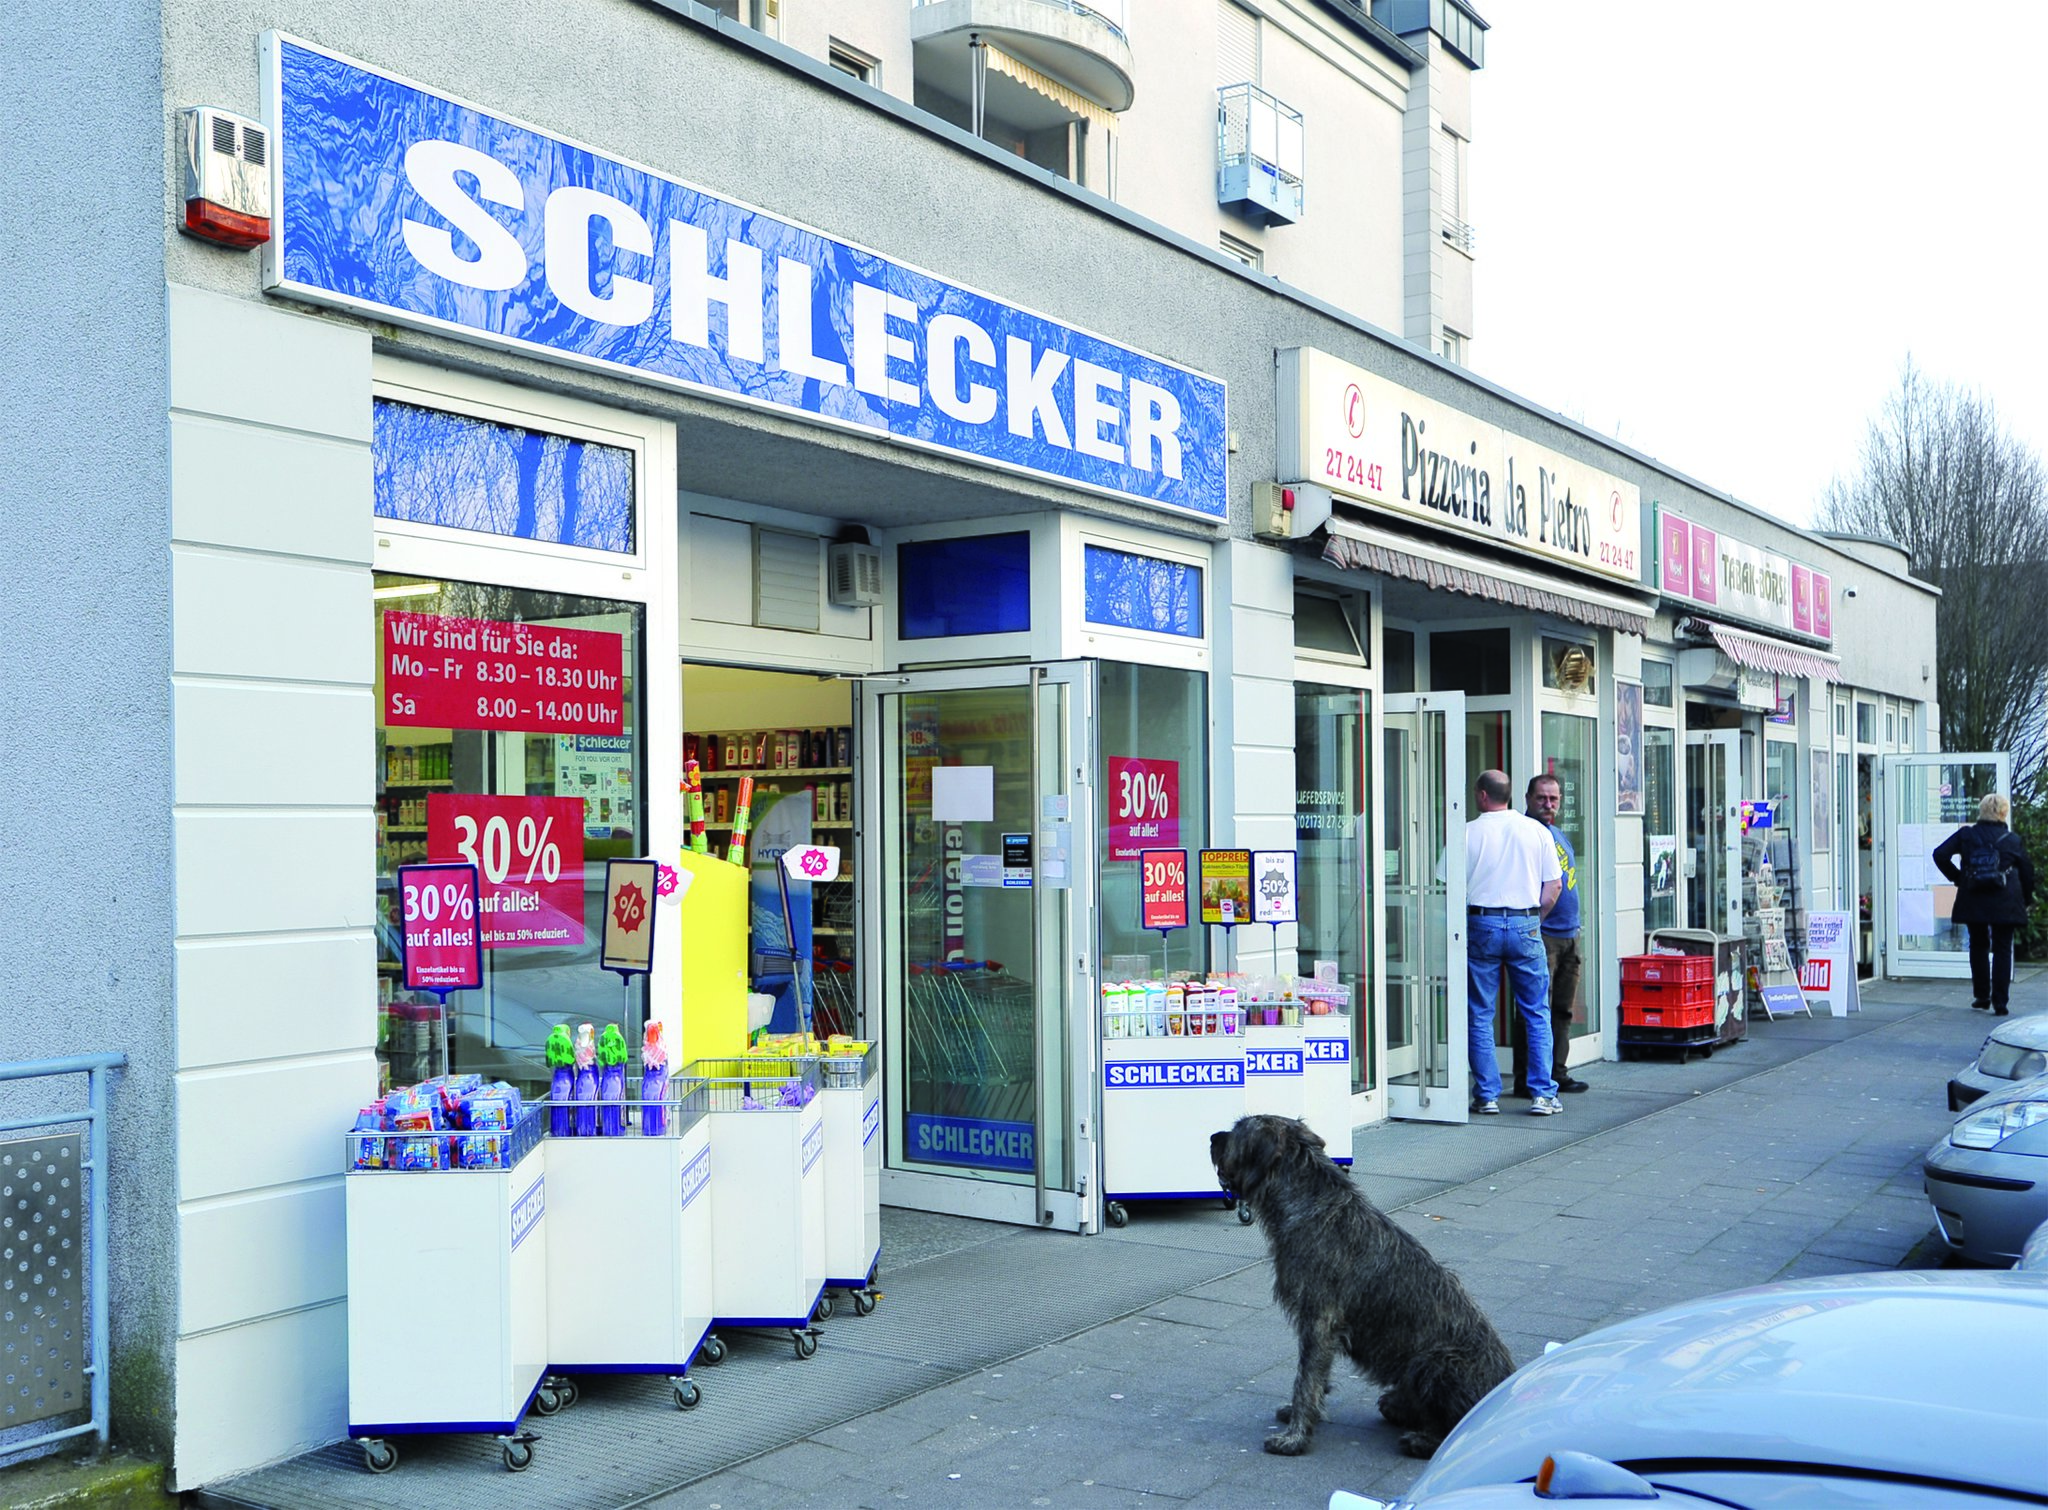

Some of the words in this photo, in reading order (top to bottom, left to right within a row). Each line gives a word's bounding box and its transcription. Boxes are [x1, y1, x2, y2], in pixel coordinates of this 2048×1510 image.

[403, 139, 1184, 482] SCHLECKER
[1326, 448, 1342, 478] 27
[1347, 455, 1364, 485] 24
[1367, 462, 1382, 492] 47
[1401, 411, 1492, 527] Pizzeria
[1504, 456, 1528, 538] da
[1539, 466, 1591, 557] Pietro
[1600, 541, 1611, 561] 27
[1612, 545, 1623, 567] 24
[1624, 549, 1634, 571] 47
[391, 621, 427, 646] Wir
[433, 626, 476, 651] sind
[481, 628, 511, 654] für
[515, 633, 544, 657] Sie
[549, 636, 578, 660] da:
[391, 653, 424, 678] Mo
[444, 658, 463, 680] Fr
[476, 661, 516, 684] 8.30
[535, 666, 583, 689] 18.30
[586, 669, 617, 691] Uhr
[392, 693, 416, 715] Sa
[476, 696, 517, 719] 8.00
[535, 700, 583, 722] 14.00
[587, 703, 618, 724] Uhr
[579, 736, 631, 749] Schlecker
[1119, 771, 1169, 819] 30%
[1129, 824, 1141, 837] auf
[1141, 823, 1159, 838] alles!
[454, 815, 561, 884] 30%
[1203, 852, 1249, 862] TOPPREIS
[1144, 862, 1185, 887] 30%
[1261, 880, 1288, 893] 50%
[404, 884, 474, 921] 30%
[478, 892, 500, 913] auf
[502, 891, 540, 912] alles!
[1145, 891, 1160, 903] auf
[1161, 890, 1184, 903] alles!
[406, 928, 429, 947] auf
[432, 928, 473, 947] alles!
[494, 930, 505, 941] bis
[506, 931, 516, 940] zu
[517, 930, 533, 941] 50%
[534, 928, 570, 940] reduziert.
[1109, 1064, 1240, 1085] SCHLECKER
[918, 1123, 1033, 1159] SCHLECKER
